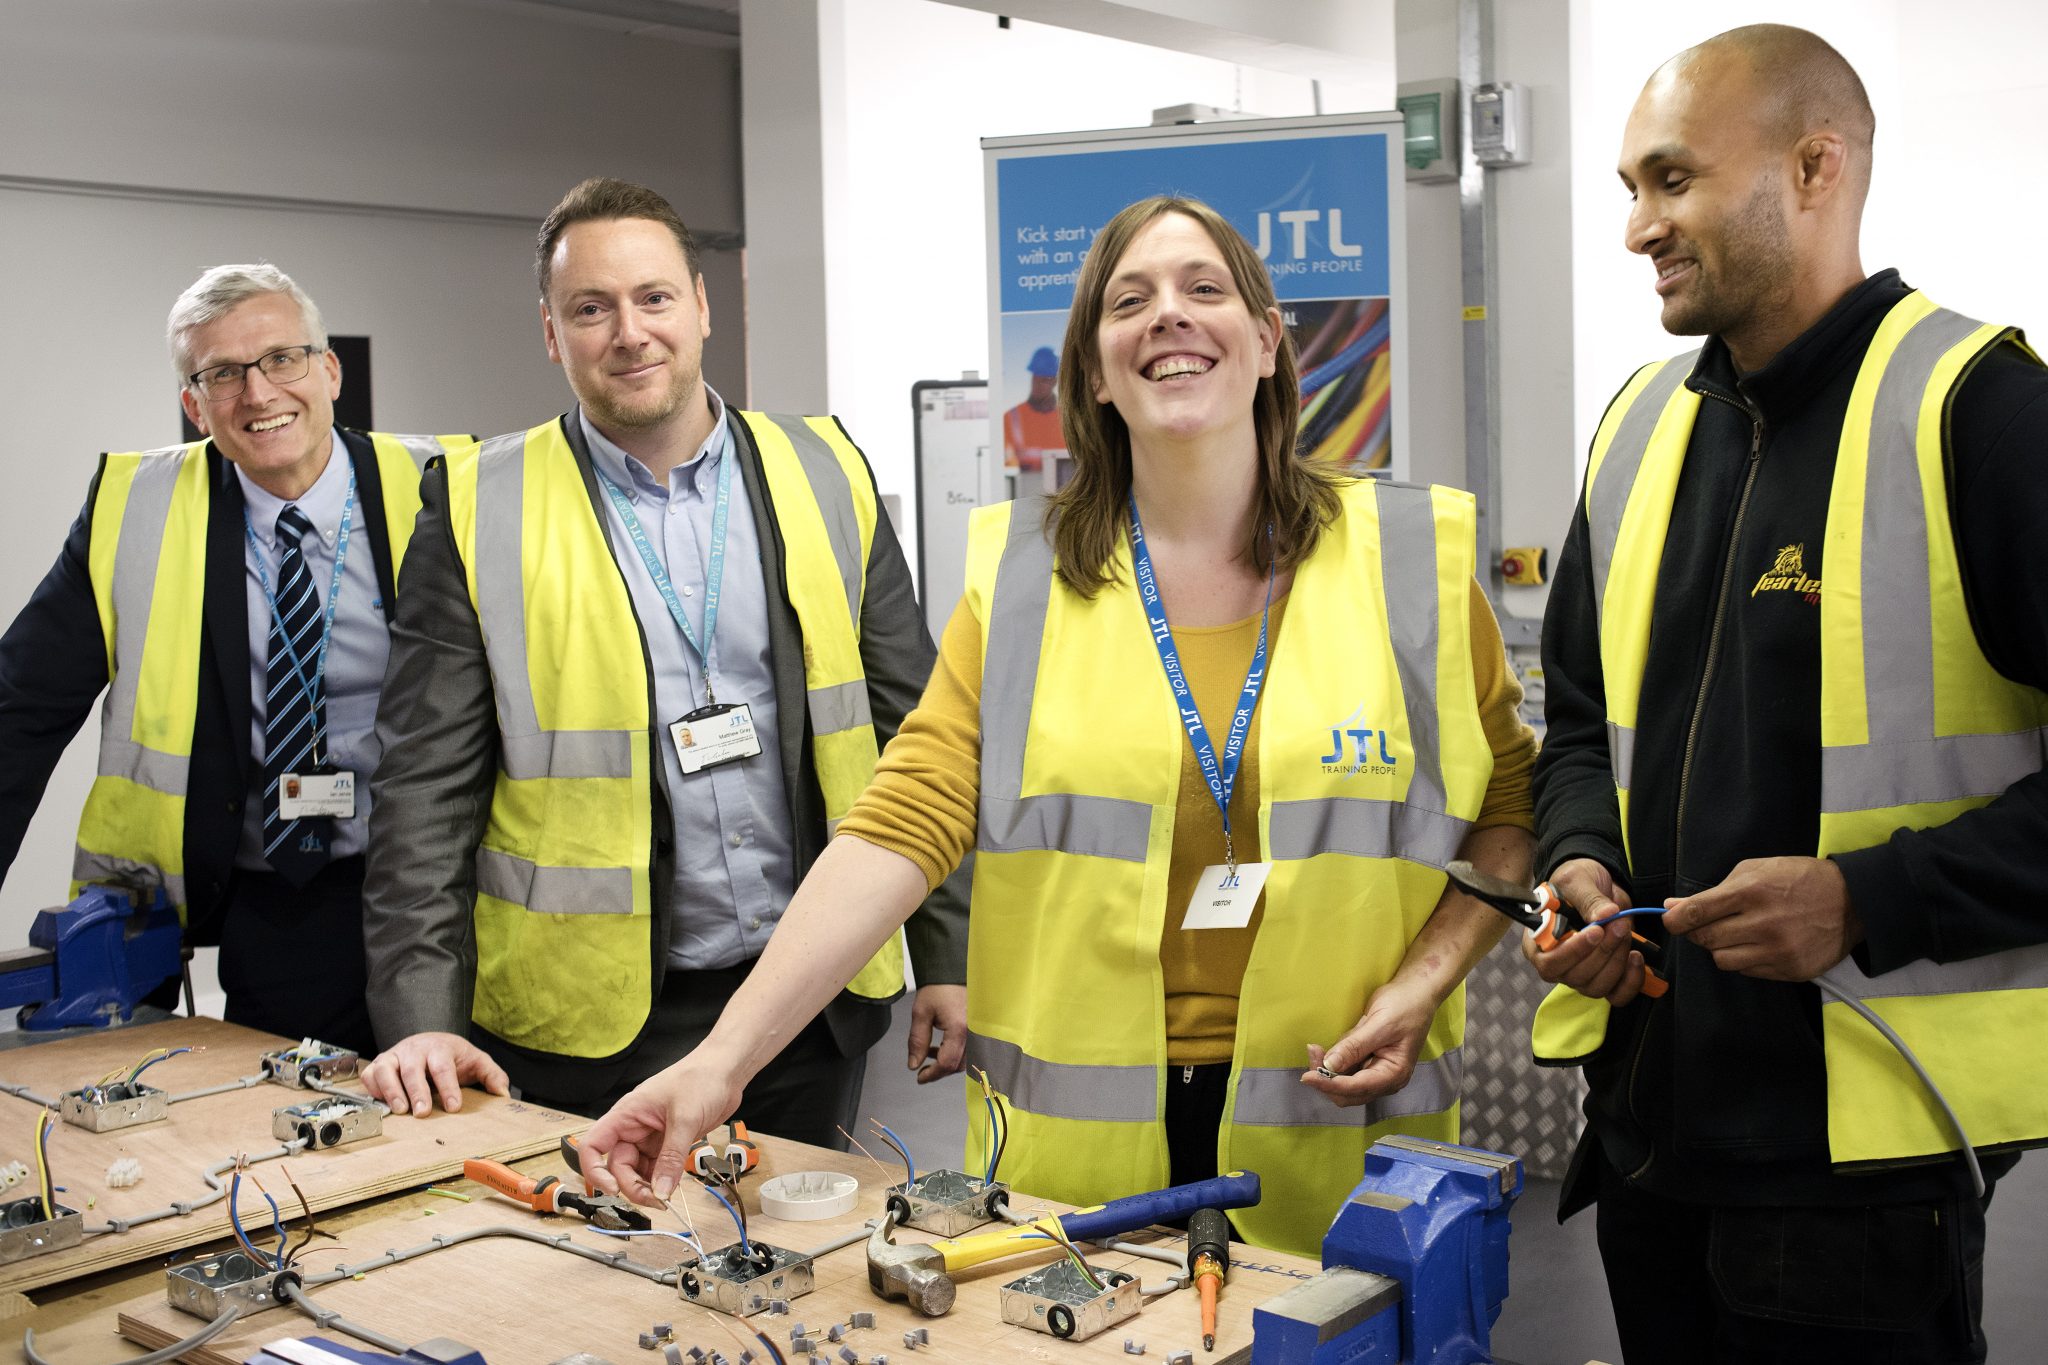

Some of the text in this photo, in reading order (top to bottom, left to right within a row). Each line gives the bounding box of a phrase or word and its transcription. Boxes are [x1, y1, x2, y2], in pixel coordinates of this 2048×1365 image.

[1017, 225, 1048, 243] Kick
[1054, 226, 1085, 241] start
[1255, 208, 1362, 260] JTL
[1017, 247, 1048, 264] with
[1053, 251, 1073, 263] an
[1267, 260, 1362, 274] NING PEOPLE
[717, 486, 729, 506] JTL
[629, 521, 646, 544] JTL
[711, 537, 724, 557] JTL
[654, 571, 673, 592] JTL
[1751, 572, 1822, 598] fearle
[706, 588, 718, 611] JTL
[1138, 556, 1158, 606] VISITOR
[1150, 617, 1170, 644] JTL
[1164, 651, 1188, 697] VISITOR
[1181, 708, 1202, 736] JTL
[1198, 744, 1224, 800] VISITOR
[730, 714, 749, 727] JTL
[1225, 708, 1250, 759] VISITOR
[1244, 669, 1263, 697] JTL
[718, 731, 738, 740] Matthew
[1321, 730, 1397, 765] JTL
[1321, 766, 1368, 774] TRAINING
[333, 780, 351, 789] JTL
[1219, 876, 1240, 888] JTL
